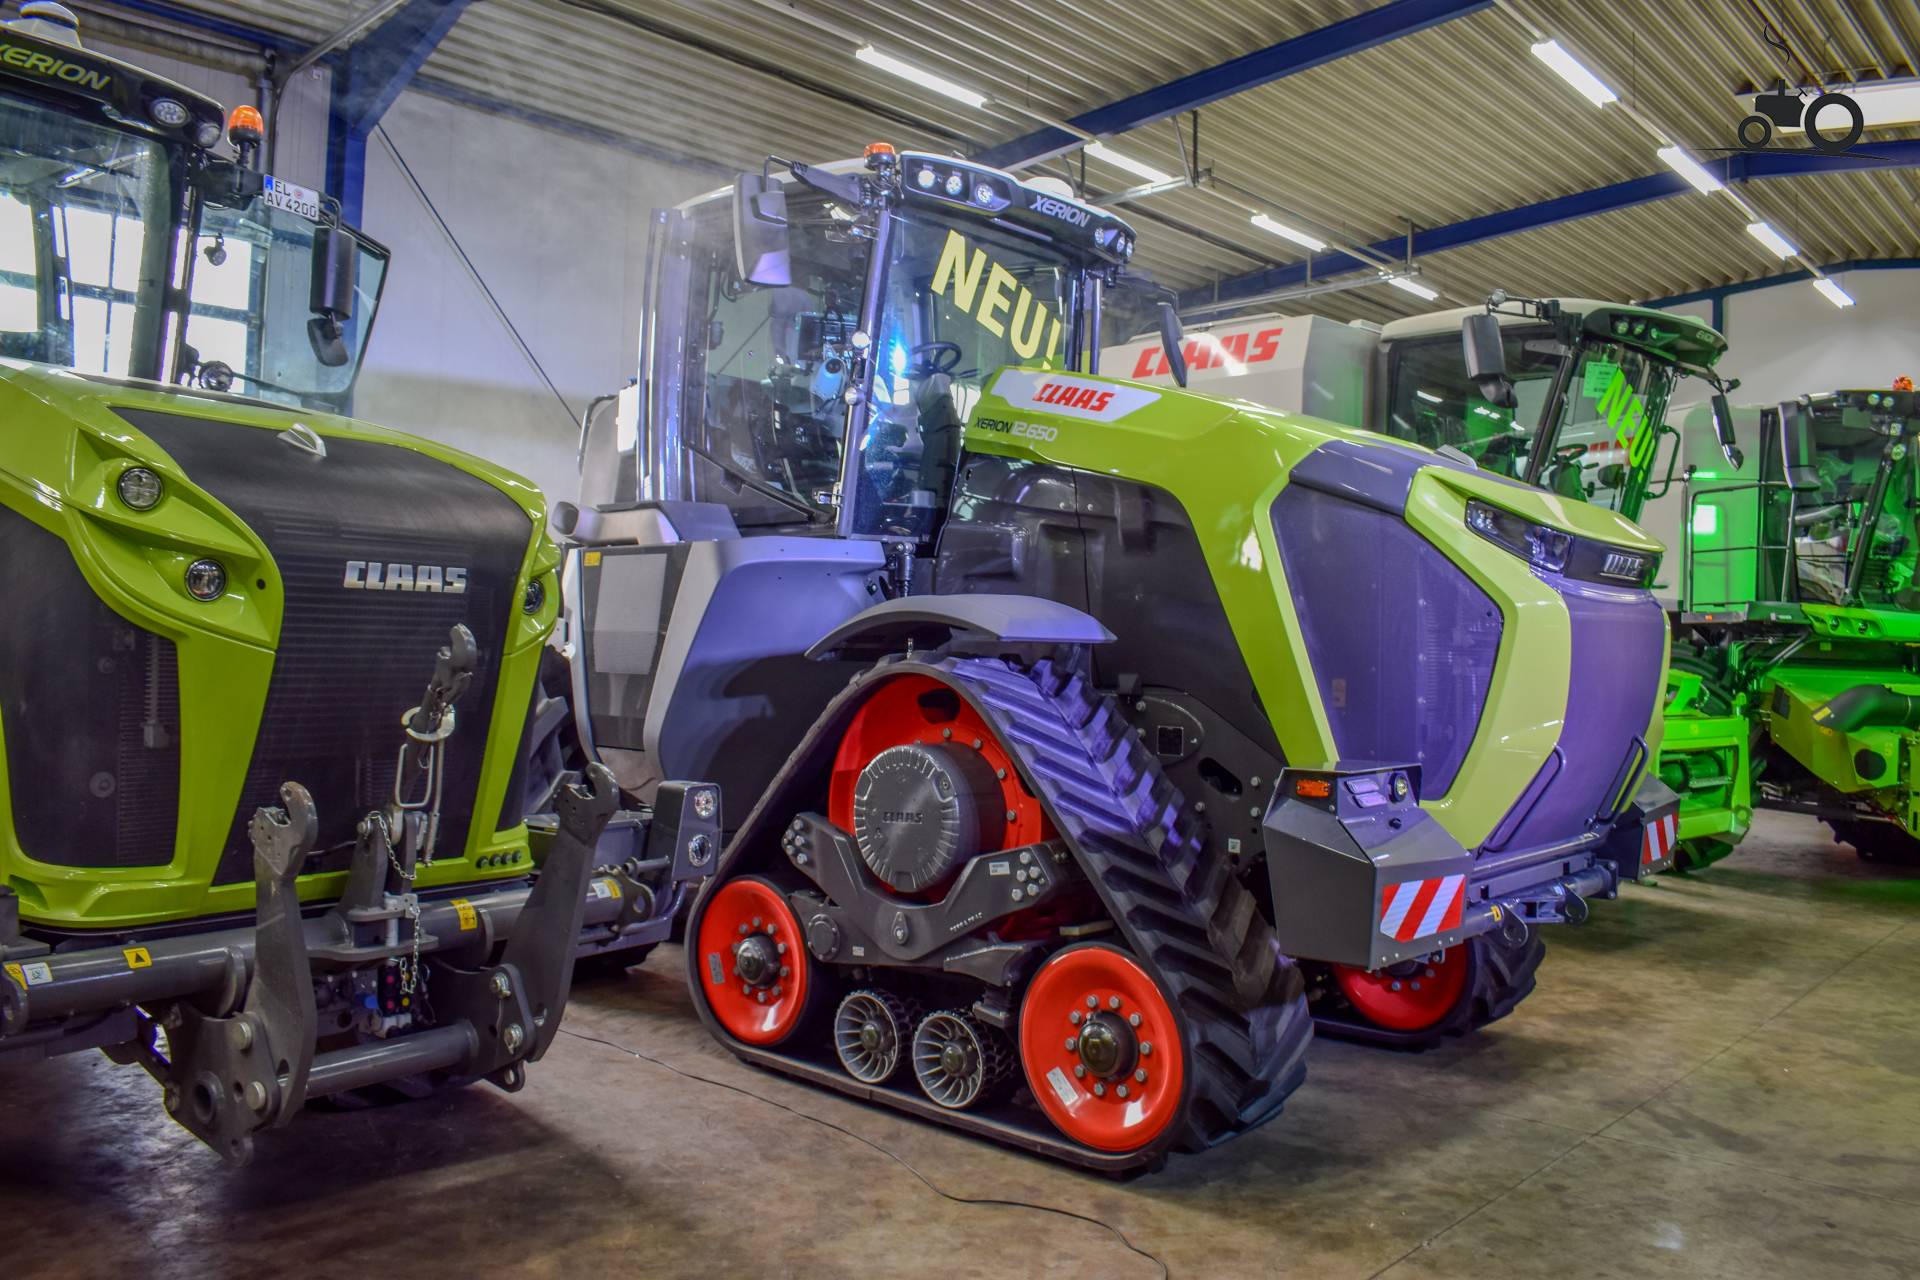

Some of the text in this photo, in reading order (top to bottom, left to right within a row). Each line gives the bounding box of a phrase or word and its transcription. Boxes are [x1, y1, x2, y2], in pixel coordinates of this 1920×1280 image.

[275, 181, 290, 196] EL
[267, 192, 317, 218] AV 4200
[1029, 195, 1090, 228] XERION
[931, 229, 1061, 370] NEU!
[1032, 383, 1116, 412] CLAAS
[975, 416, 1013, 434] XERION
[1596, 367, 1656, 483] NEU!
[343, 560, 467, 594] CLAAS
[882, 811, 923, 824] CLAAS
